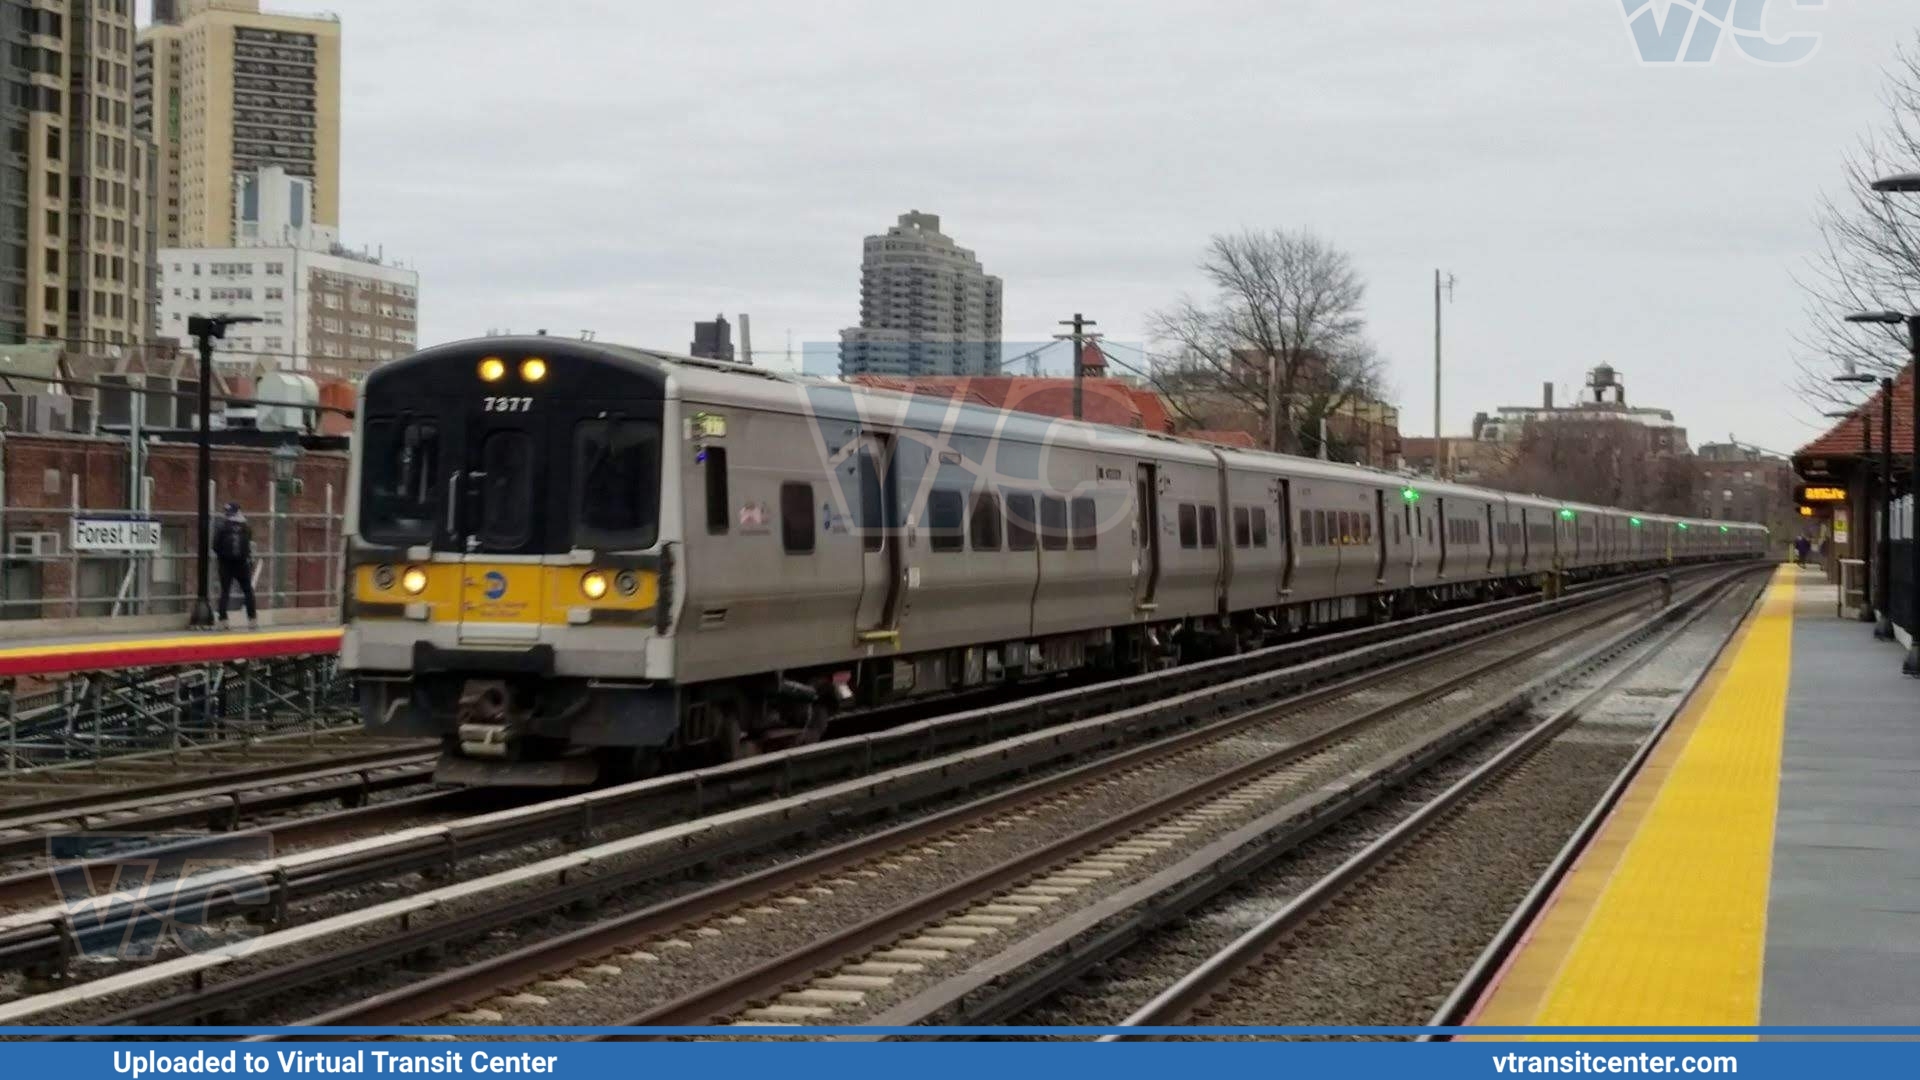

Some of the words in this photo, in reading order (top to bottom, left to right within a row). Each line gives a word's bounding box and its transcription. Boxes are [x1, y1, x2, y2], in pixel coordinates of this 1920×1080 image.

[483, 396, 534, 412] 7377
[77, 521, 123, 544] Forest
[129, 521, 158, 545] Hills
